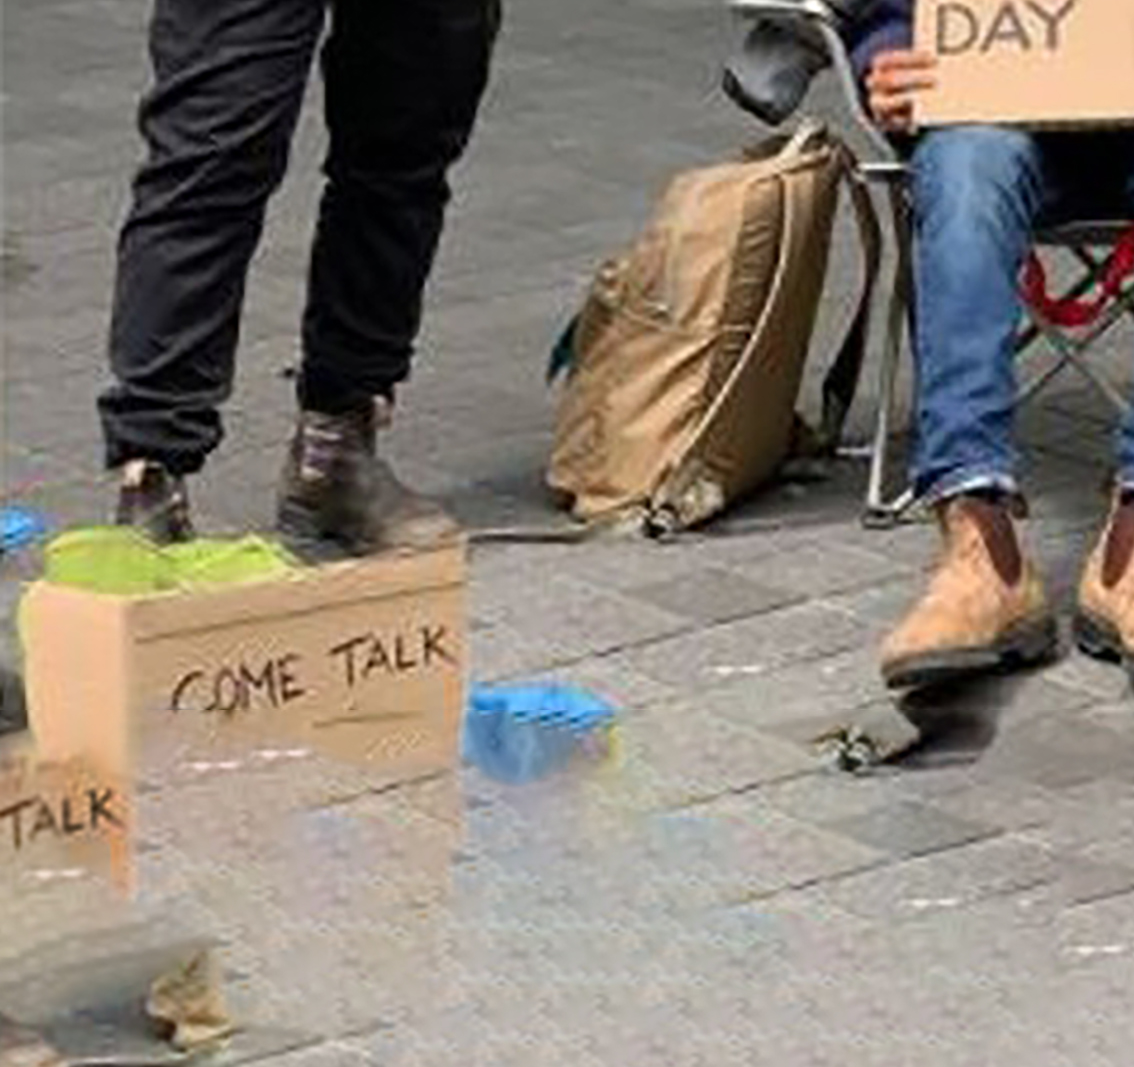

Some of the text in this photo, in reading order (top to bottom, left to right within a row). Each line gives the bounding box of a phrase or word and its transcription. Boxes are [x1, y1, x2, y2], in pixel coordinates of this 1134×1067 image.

[170, 626, 456, 716] COME TALK
[0, 789, 125, 850] TALK
